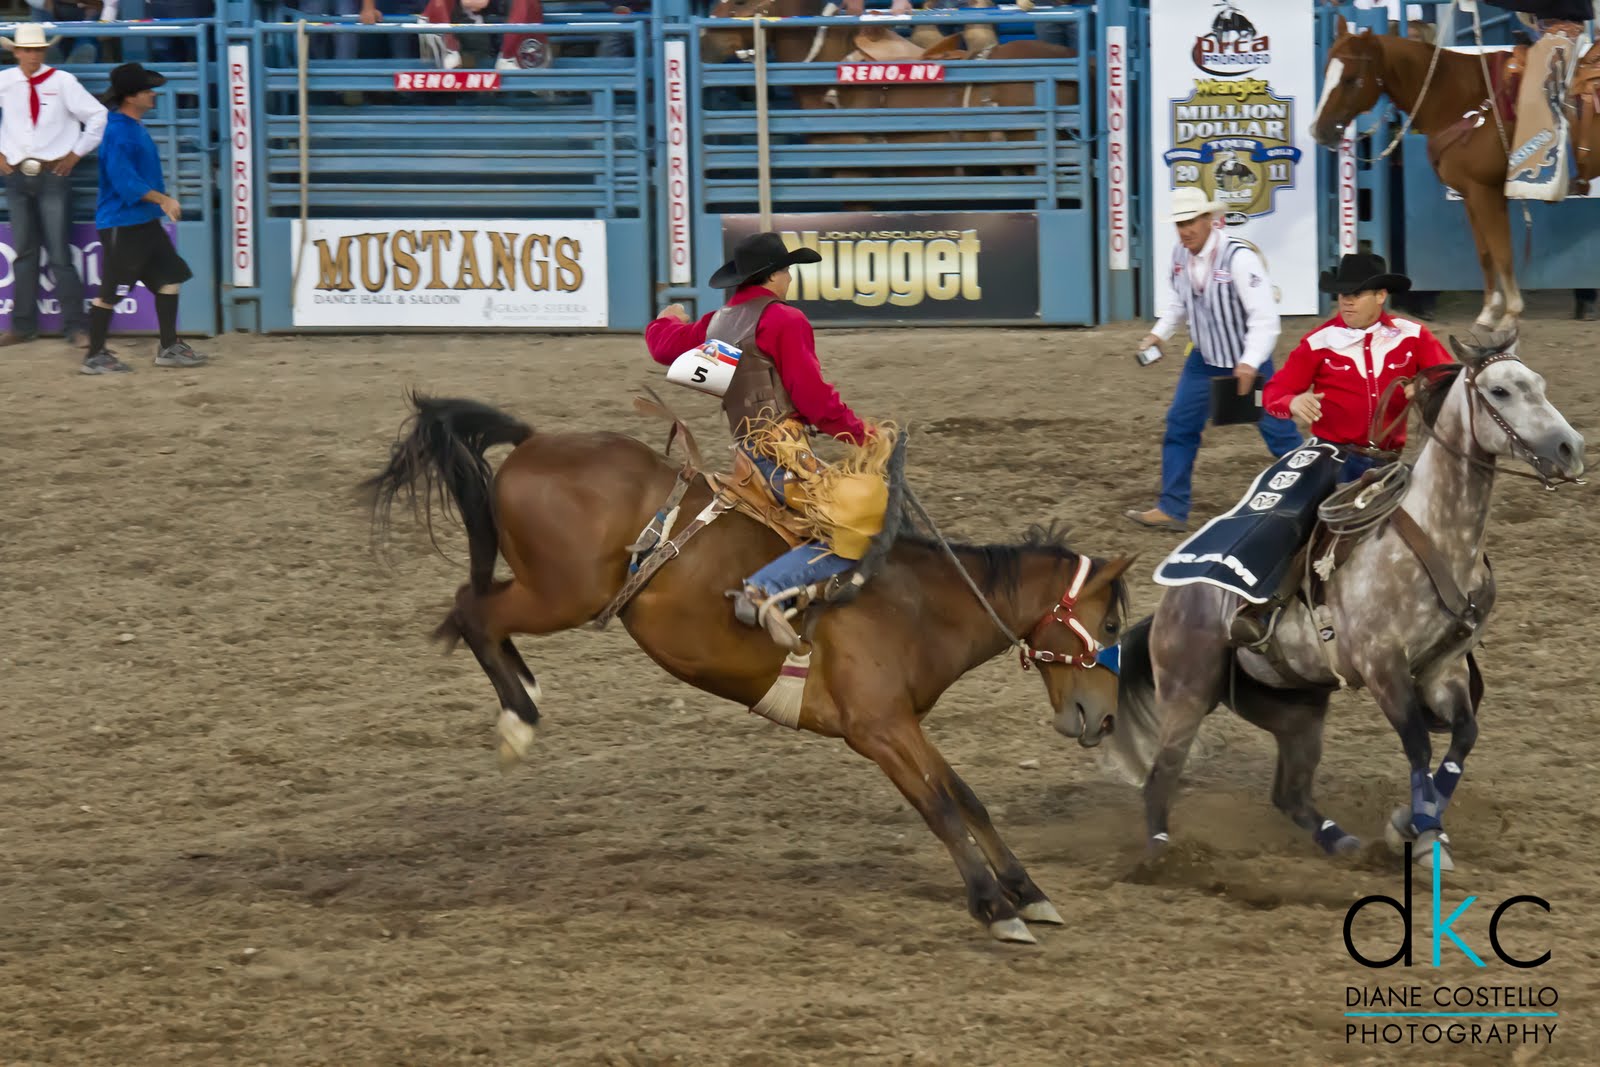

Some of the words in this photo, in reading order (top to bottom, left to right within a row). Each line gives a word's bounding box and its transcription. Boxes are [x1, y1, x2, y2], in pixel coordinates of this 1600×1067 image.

[231, 63, 248, 150] RENO
[667, 59, 683, 146] RENO
[1109, 44, 1123, 132] RENO
[1176, 103, 1287, 121] MILLION
[1193, 77, 1269, 103] Wrangler
[1176, 120, 1287, 143] DOLLAR
[1110, 142, 1124, 252] RODEO
[1176, 164, 1200, 182] 20
[1268, 163, 1288, 181] 11
[233, 160, 250, 269] RODEO
[671, 157, 687, 265] RODEO
[818, 231, 865, 241] JOHN
[313, 229, 584, 293] MUSTANGS
[779, 229, 983, 307] Nugget
[313, 294, 357, 305] DANCE
[360, 294, 394, 305] HALL
[397, 294, 406, 305] &
[409, 294, 461, 305] SALOON
[691, 365, 709, 383] 5
